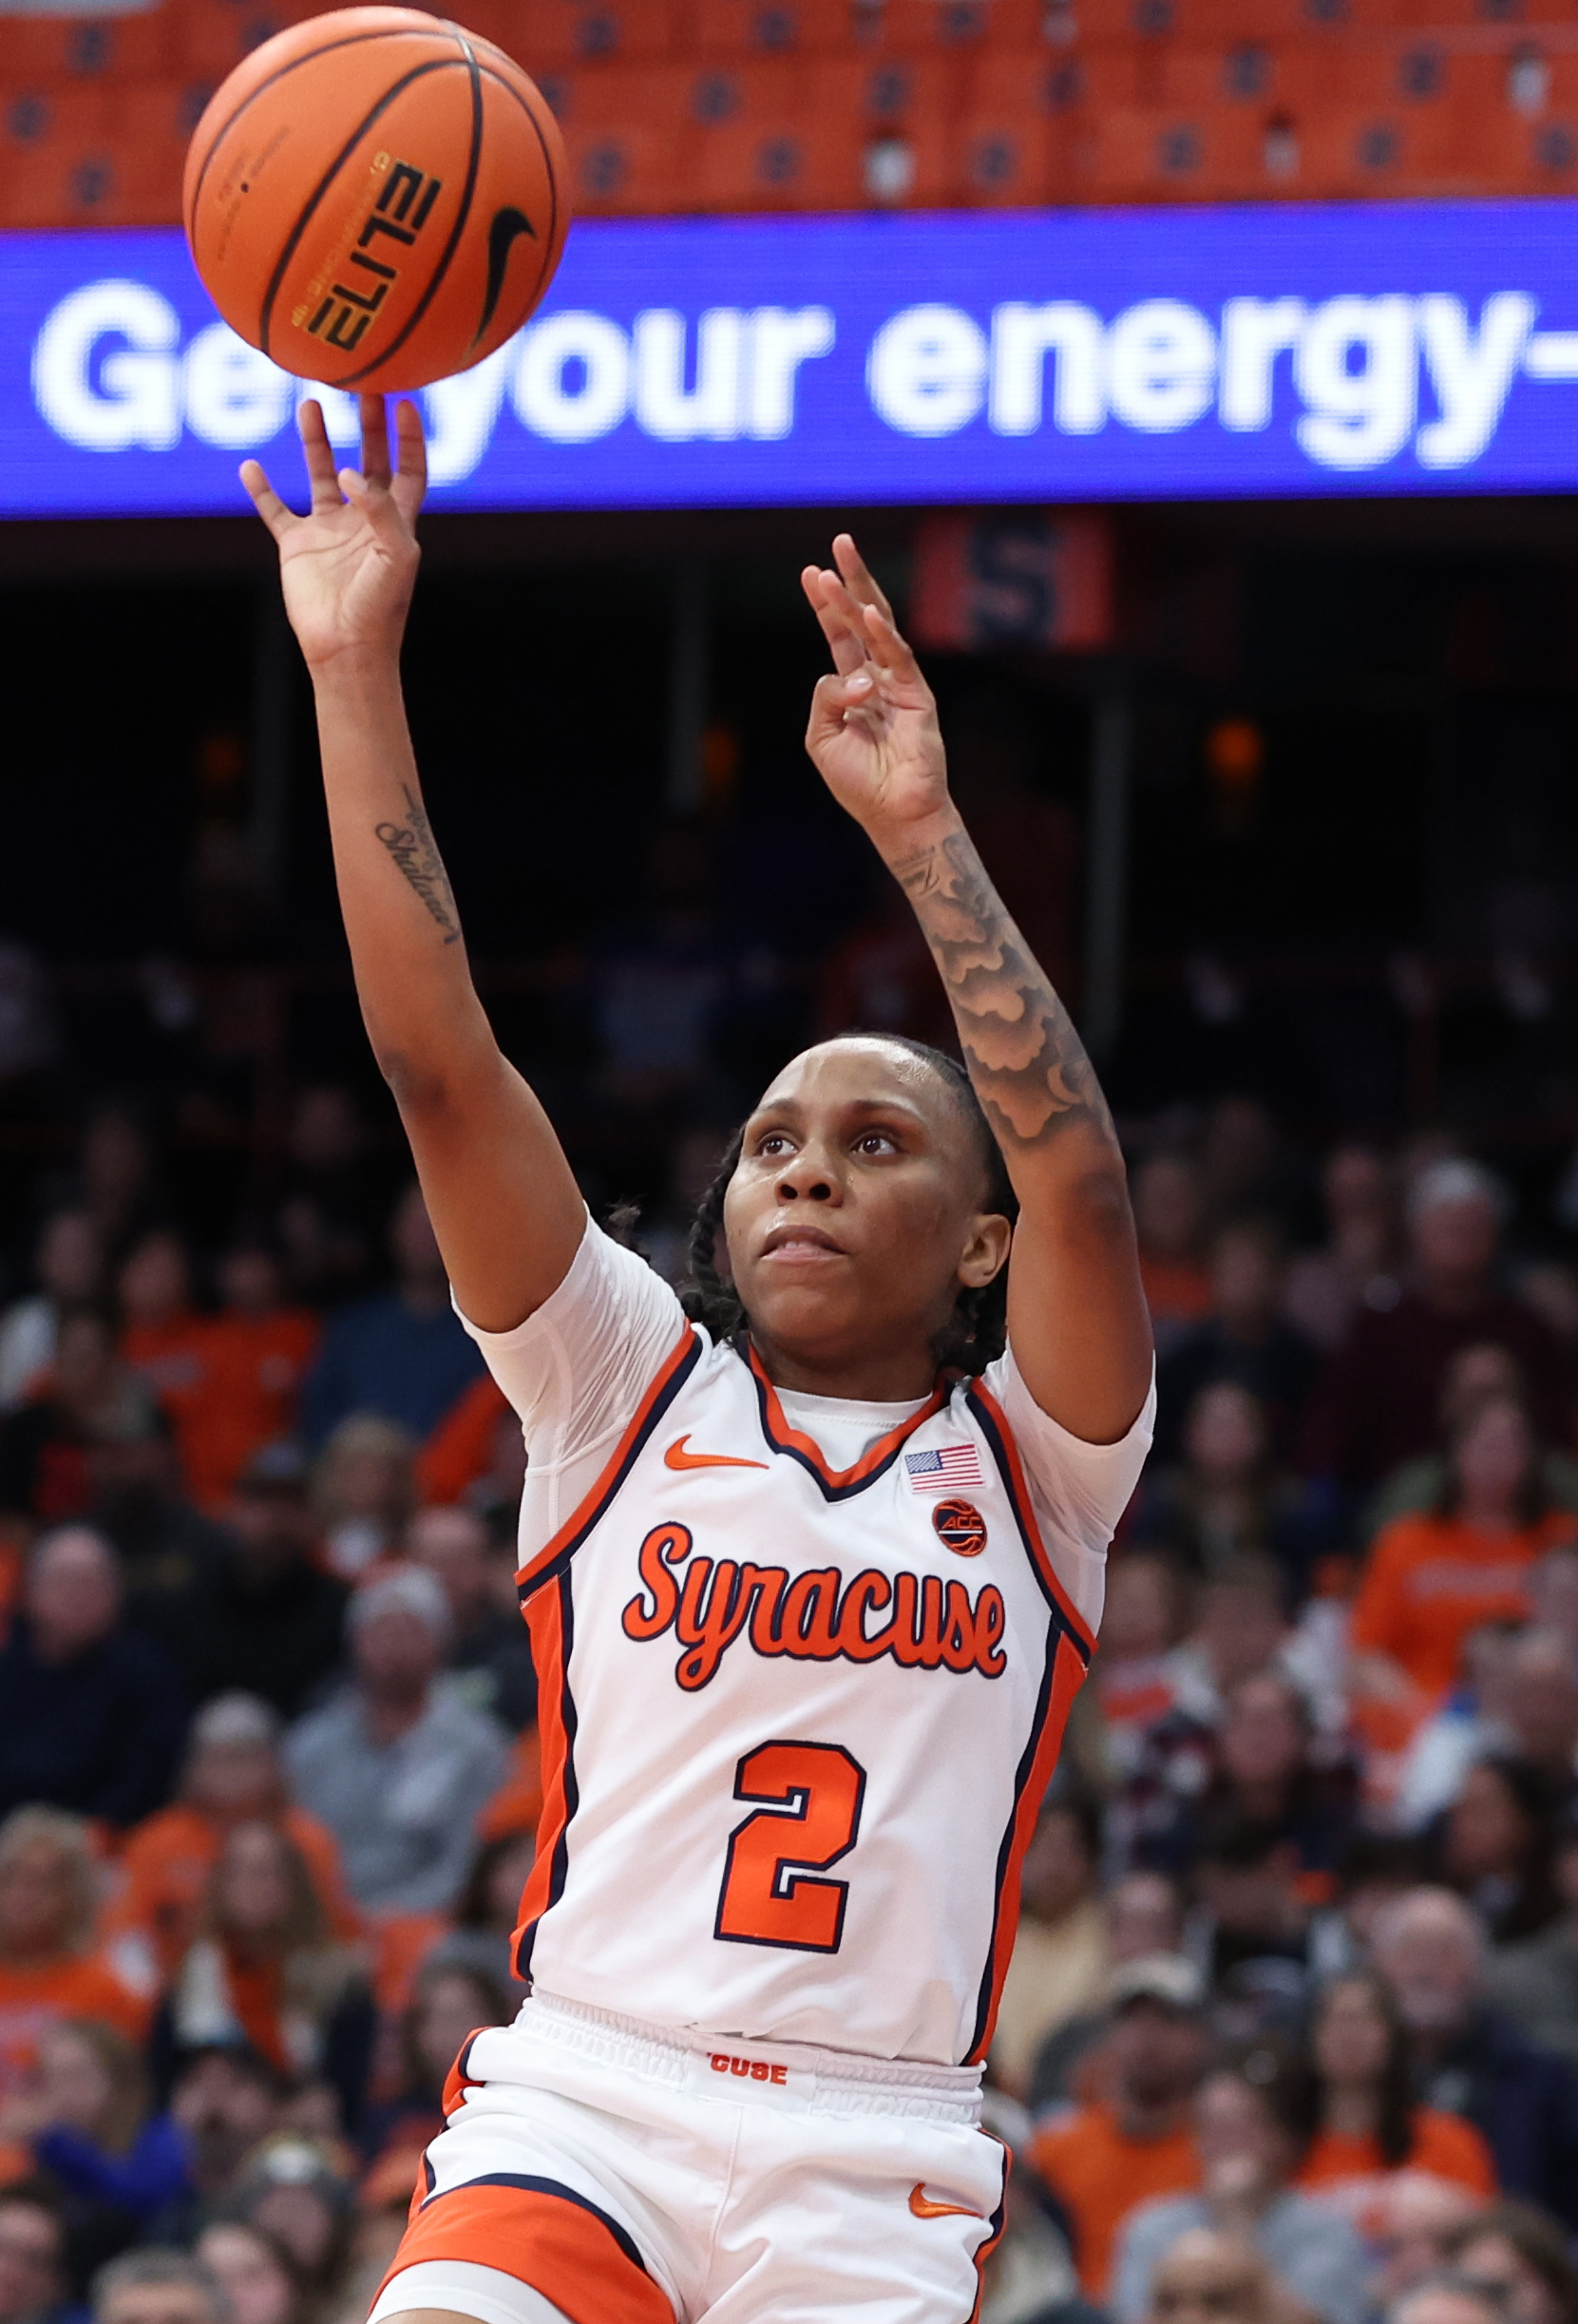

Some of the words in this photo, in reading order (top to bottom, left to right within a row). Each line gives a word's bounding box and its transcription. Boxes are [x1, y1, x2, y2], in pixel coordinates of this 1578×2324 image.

[307, 159, 443, 352] ELITE
[621, 1520, 1008, 1692] Syracuse
[941, 1515, 983, 1531] ACC
[713, 1739, 867, 1954] 2
